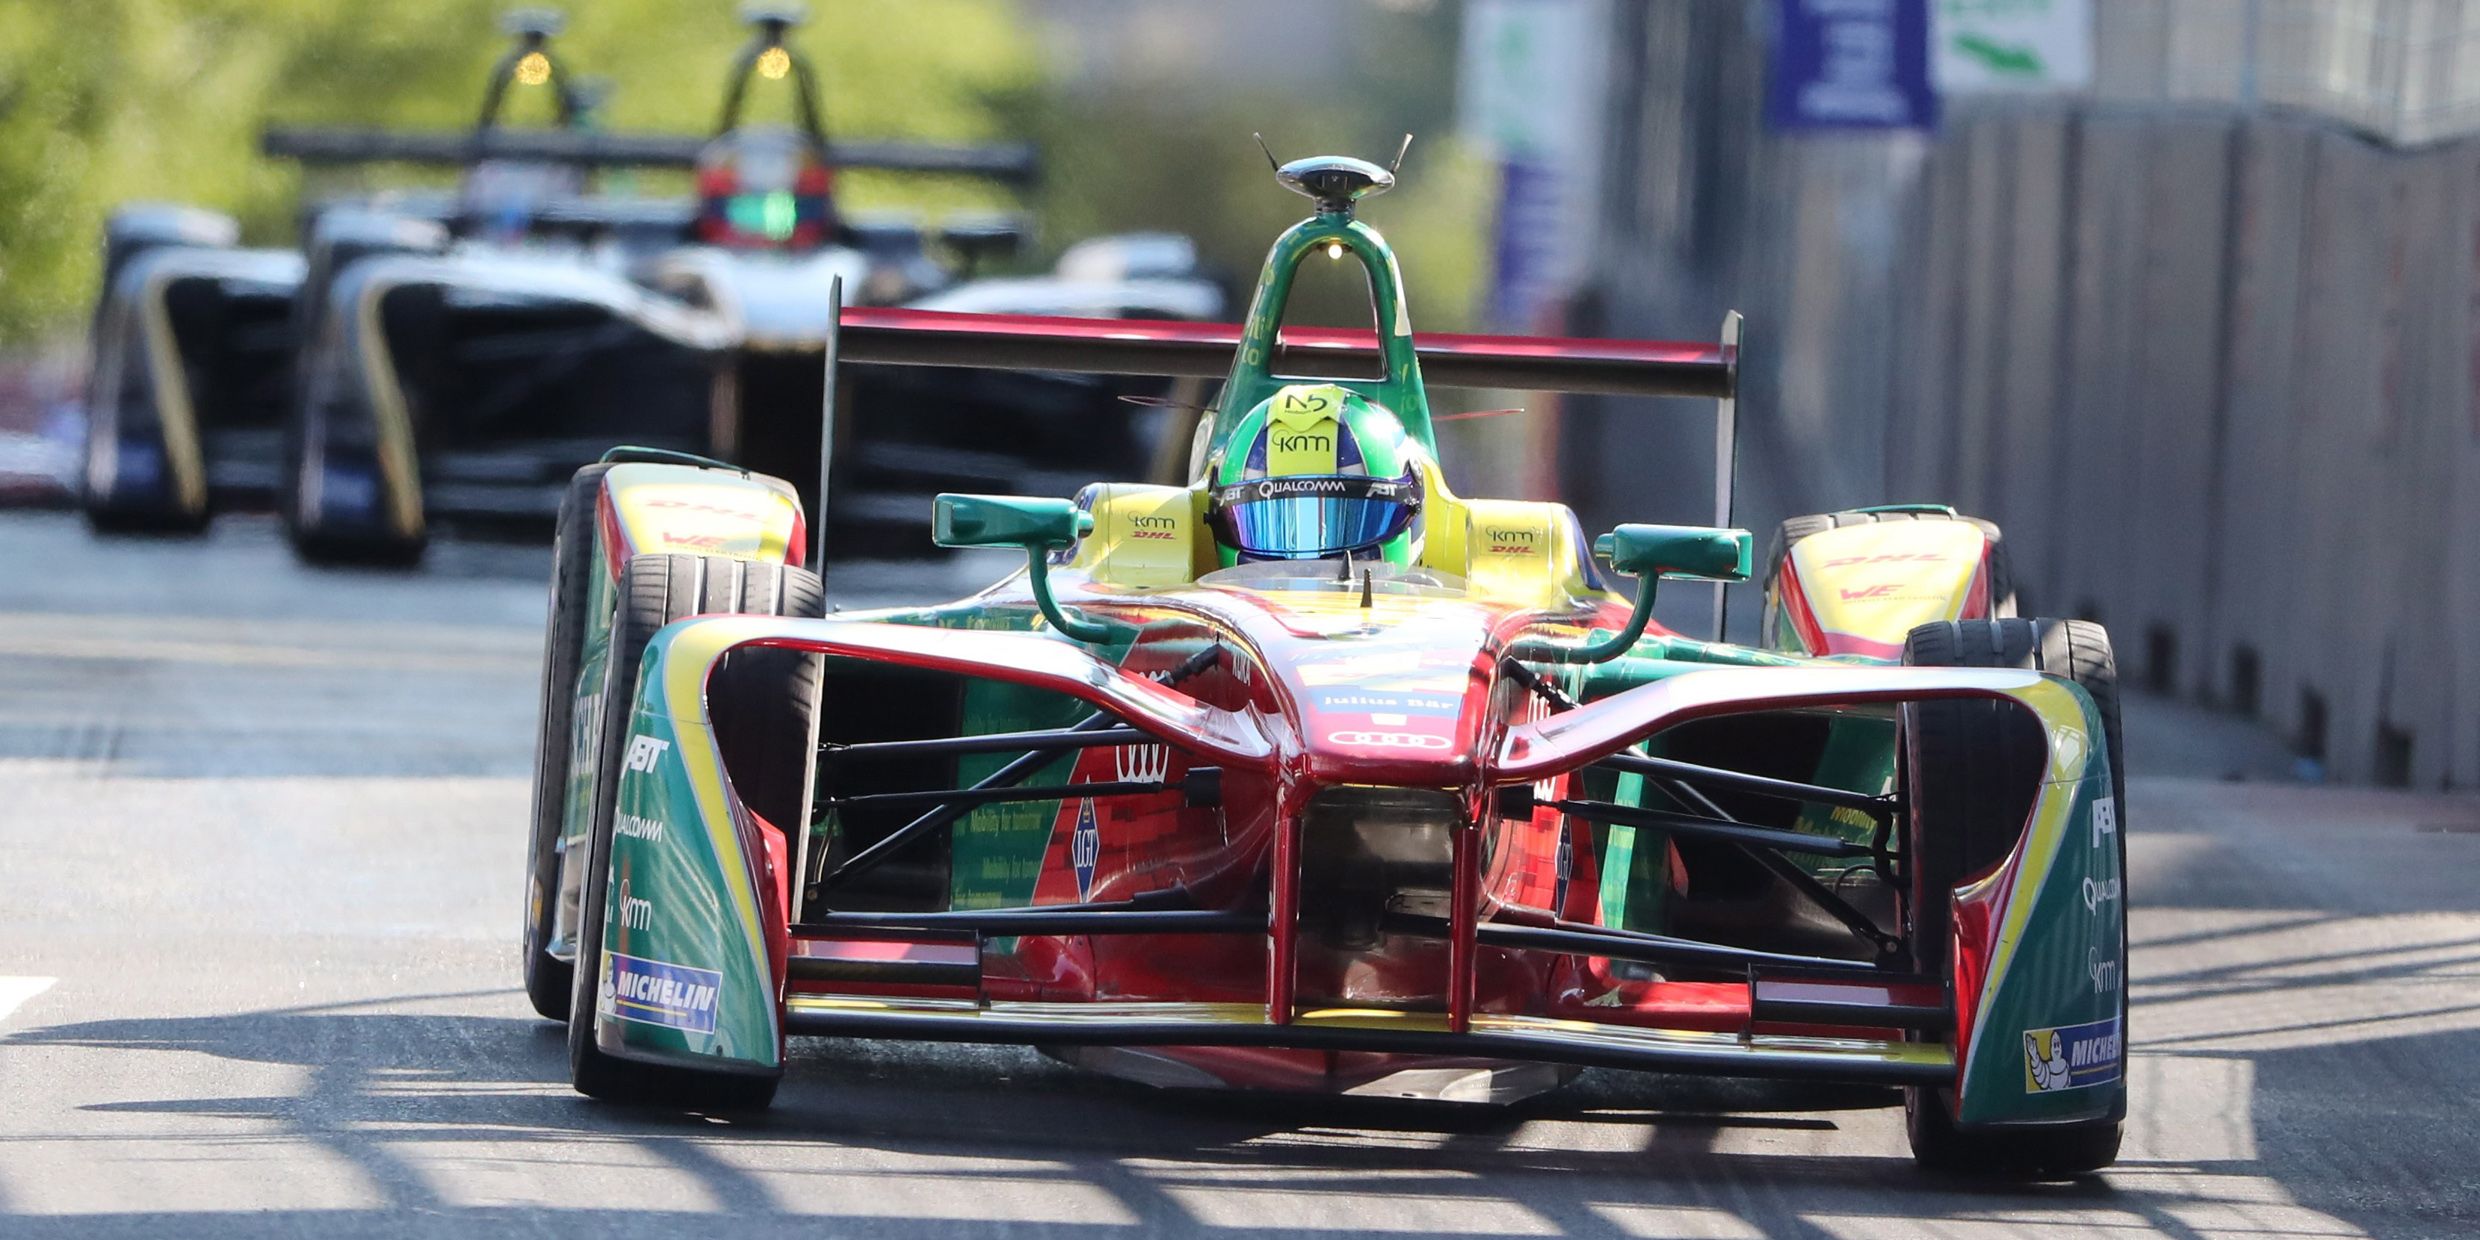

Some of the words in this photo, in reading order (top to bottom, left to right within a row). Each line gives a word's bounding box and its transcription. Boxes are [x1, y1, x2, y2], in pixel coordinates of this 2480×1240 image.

[1258, 480, 1346, 499] QUALCOMM
[1365, 482, 1398, 498] ABT
[1131, 530, 1176, 540] DHL
[1488, 545, 1535, 554] DHL
[1324, 695, 1398, 706] Julius
[621, 734, 670, 779] ABT
[1076, 829, 1096, 868] LGT
[617, 970, 716, 1012] MICHELIN
[2071, 1034, 2120, 1067] MICHEL
